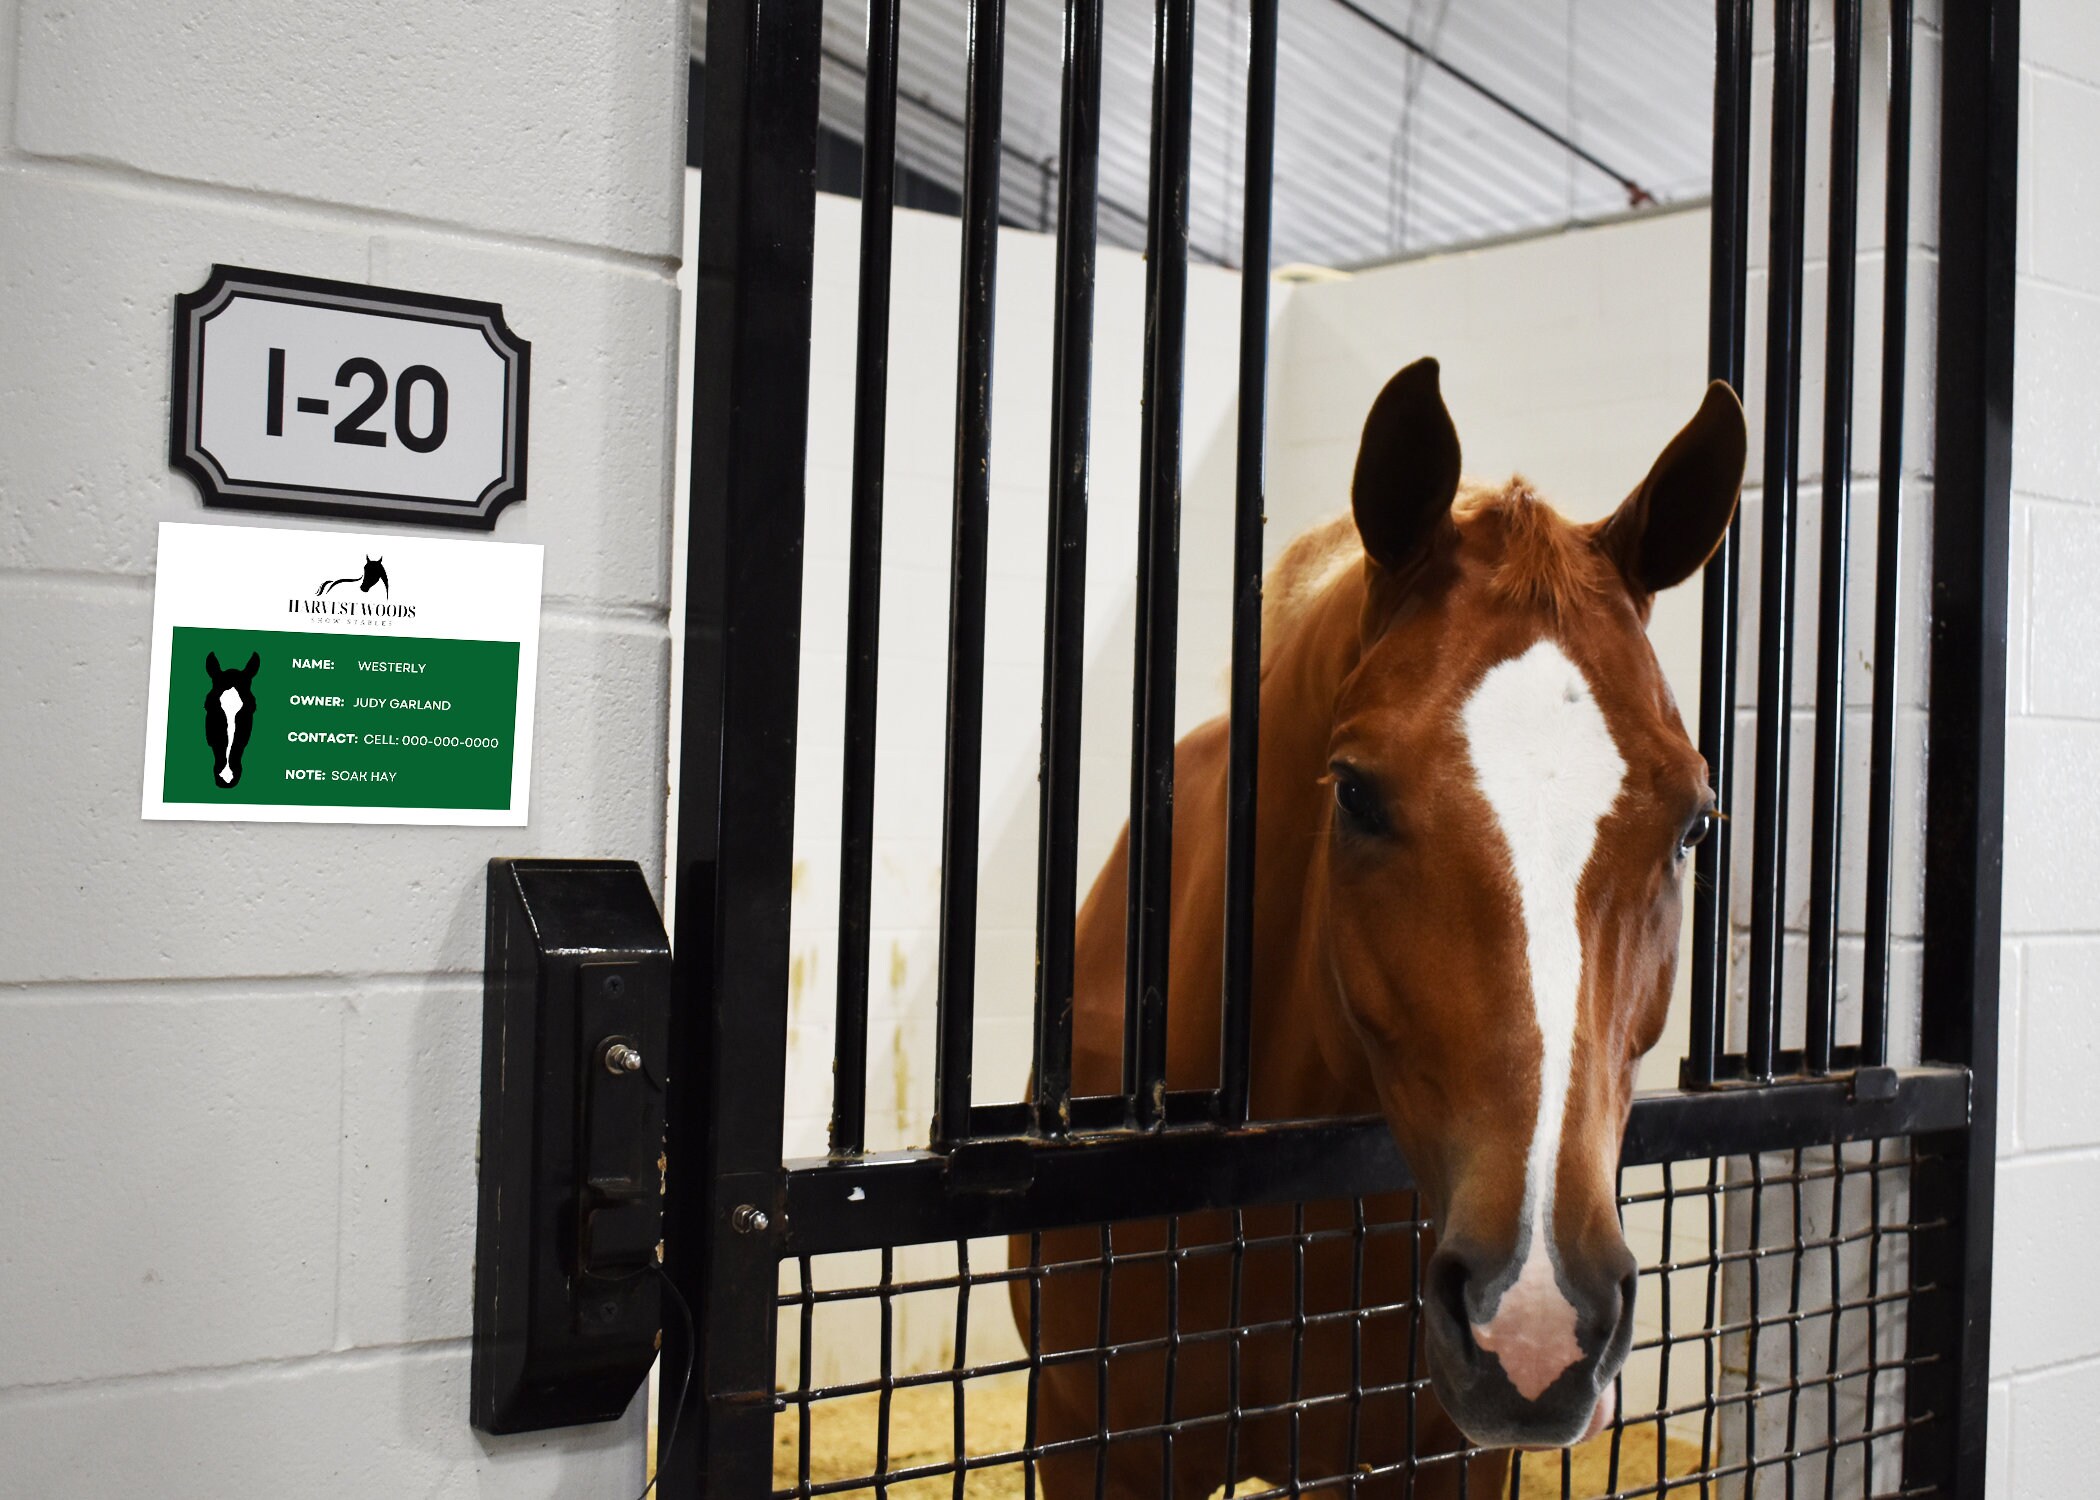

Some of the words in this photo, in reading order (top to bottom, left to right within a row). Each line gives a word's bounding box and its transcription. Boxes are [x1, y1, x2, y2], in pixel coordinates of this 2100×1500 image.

[265, 347, 449, 454] I-20
[292, 658, 335, 670] NAME:
[357, 660, 427, 674] WESTERLY
[289, 694, 345, 707] OWNER:
[352, 697, 387, 709] JUDY
[389, 698, 452, 711] GARLAND
[287, 731, 359, 744] CONTACT:
[363, 733, 400, 746] CELL:
[401, 735, 499, 749] 000-000-0000
[285, 769, 326, 781] NOTE:
[331, 770, 368, 782] SOAK
[370, 771, 397, 783] HAY
